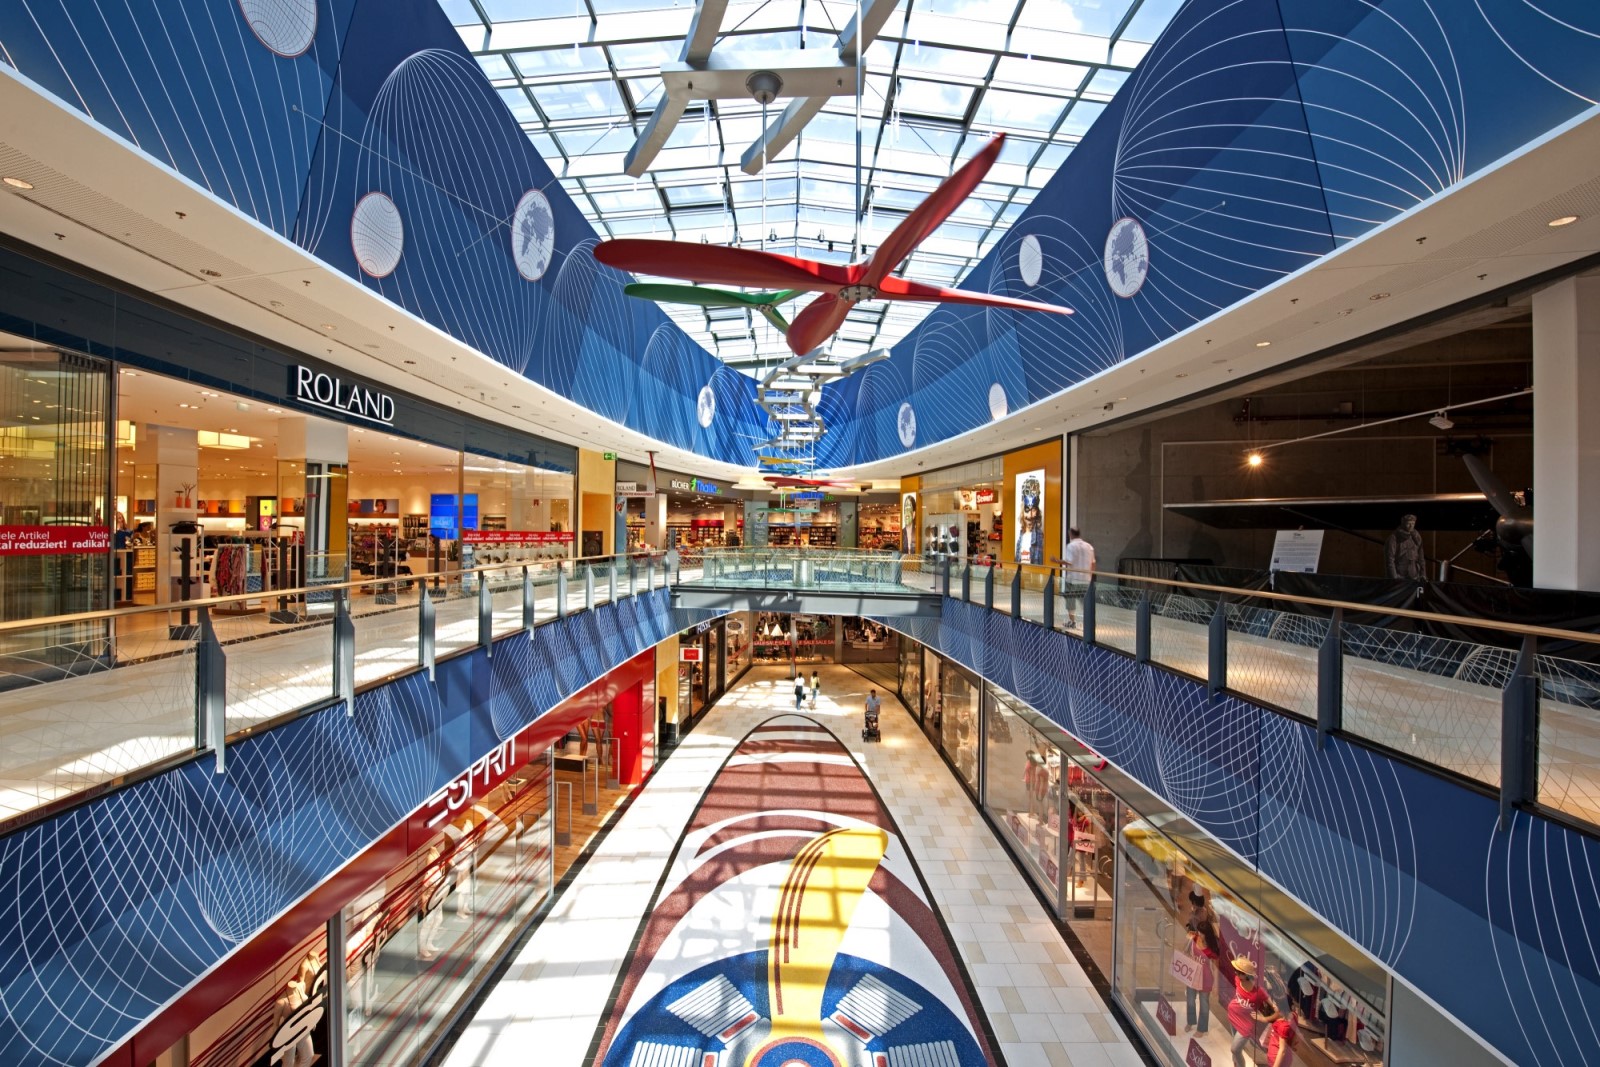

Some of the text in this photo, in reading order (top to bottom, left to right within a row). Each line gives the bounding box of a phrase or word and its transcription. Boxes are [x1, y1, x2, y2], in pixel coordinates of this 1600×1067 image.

[297, 364, 395, 422] ROLAND
[671, 479, 689, 490] BÜCHER
[18, 531, 50, 540] Artikel
[88, 532, 109, 540] Viele
[14, 539, 67, 549] reduziert!
[72, 539, 105, 549] radikal
[427, 736, 516, 829] ESPRIT
[1235, 992, 1256, 1009] Sale
